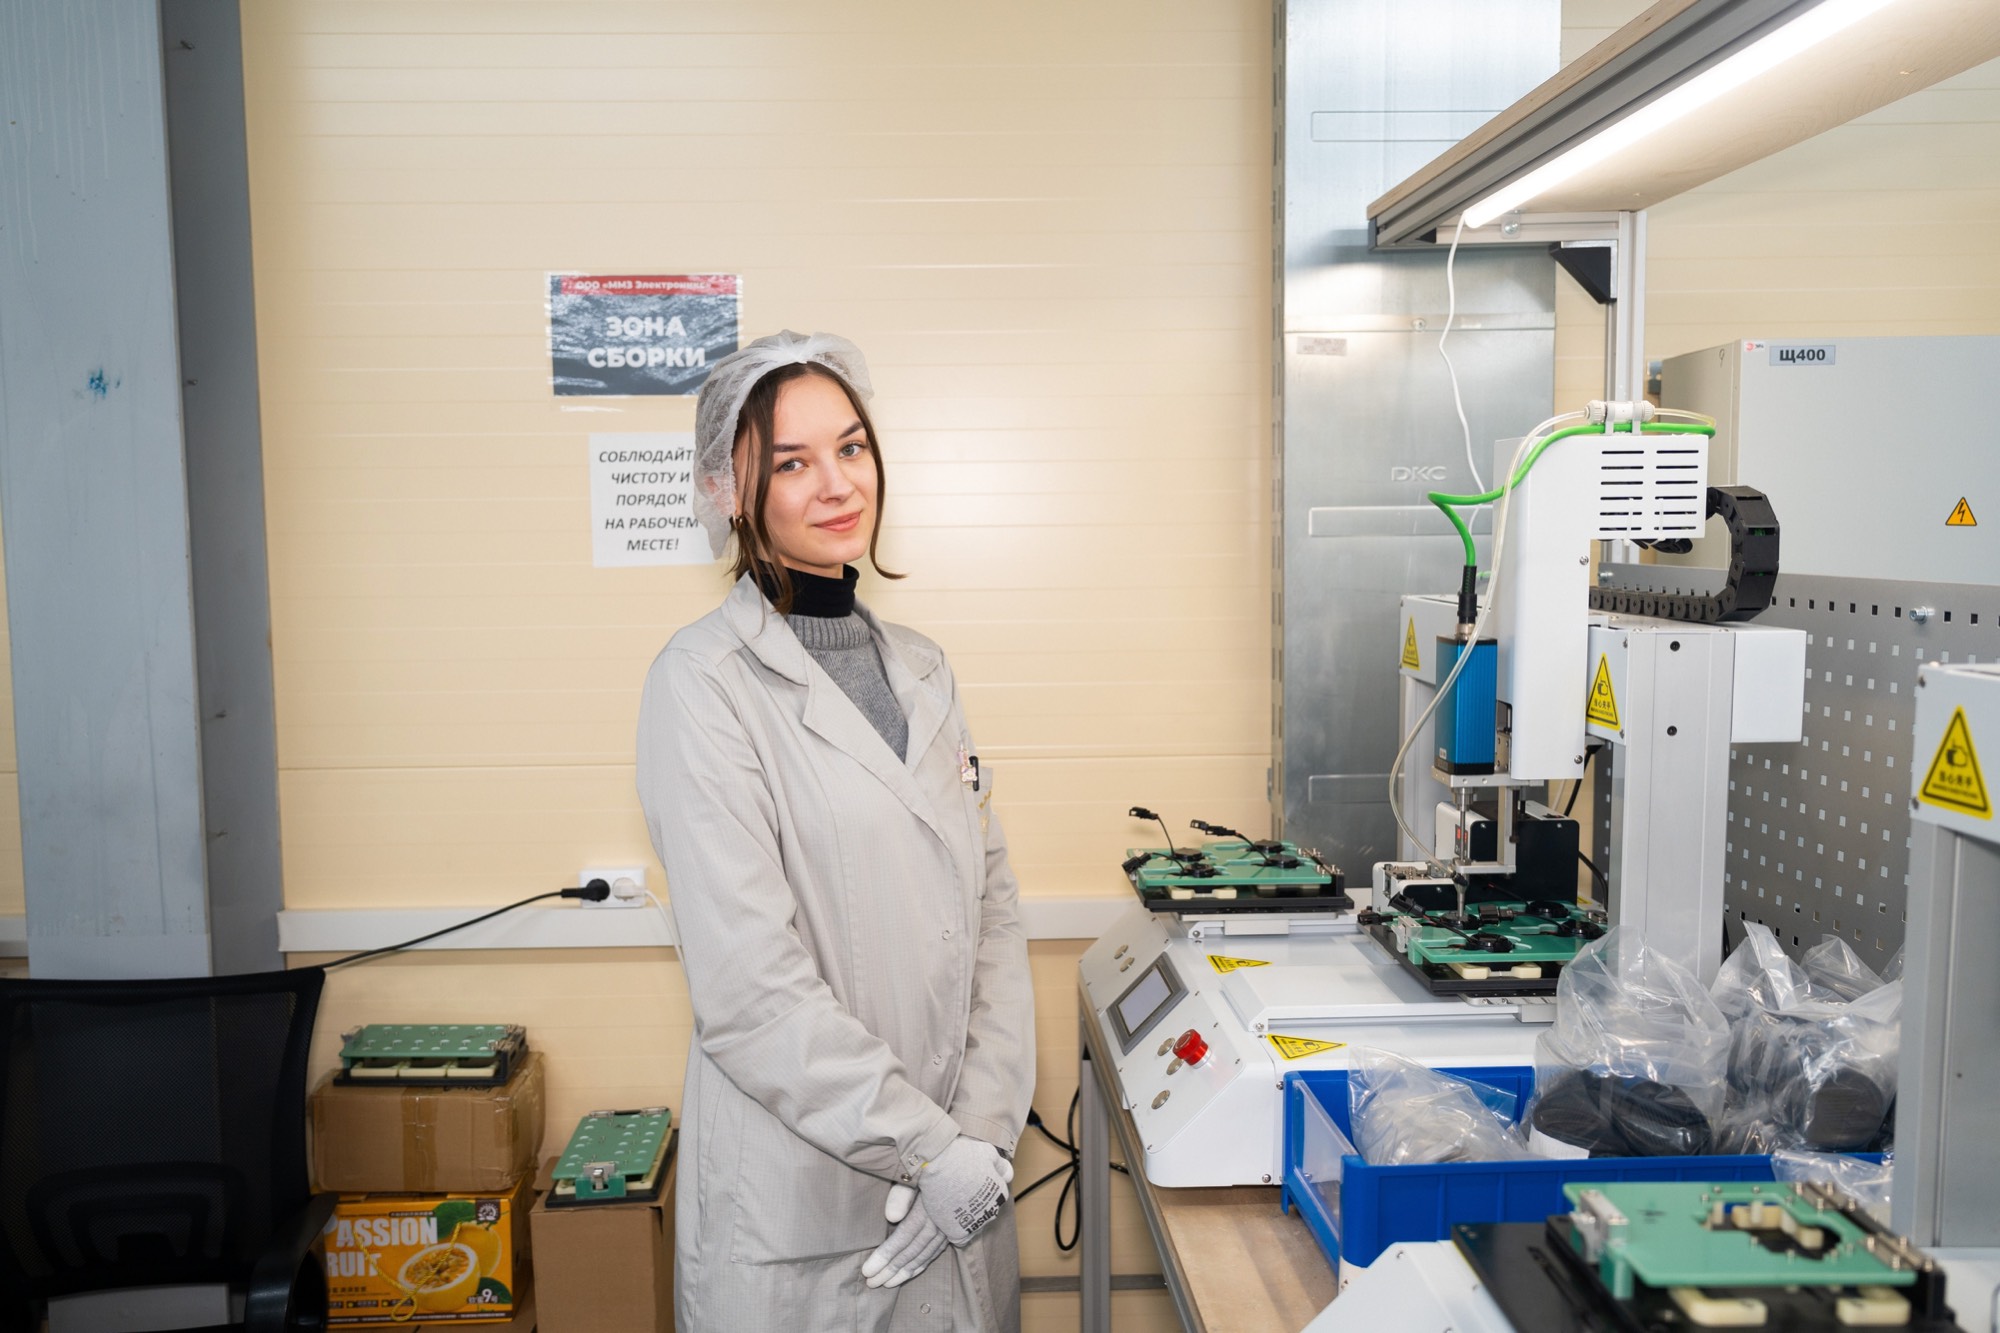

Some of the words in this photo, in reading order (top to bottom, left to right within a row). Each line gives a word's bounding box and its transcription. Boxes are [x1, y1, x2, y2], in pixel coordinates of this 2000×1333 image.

[606, 316, 686, 337] ЗОНА
[587, 347, 706, 369] СБОРКИ
[1779, 349, 1826, 363] Щ400
[599, 447, 694, 464] СОБЛЮДАЙТ
[611, 472, 677, 484] ЧИСТОТУ
[680, 472, 691, 483] И
[1391, 466, 1447, 481] DKC
[616, 493, 687, 507] ПОРЯДОК
[605, 518, 625, 530] НА
[629, 517, 699, 530] РАБОЧЕМ
[627, 538, 680, 551] МЕСТЕ!
[326, 1251, 382, 1277] RUIT
